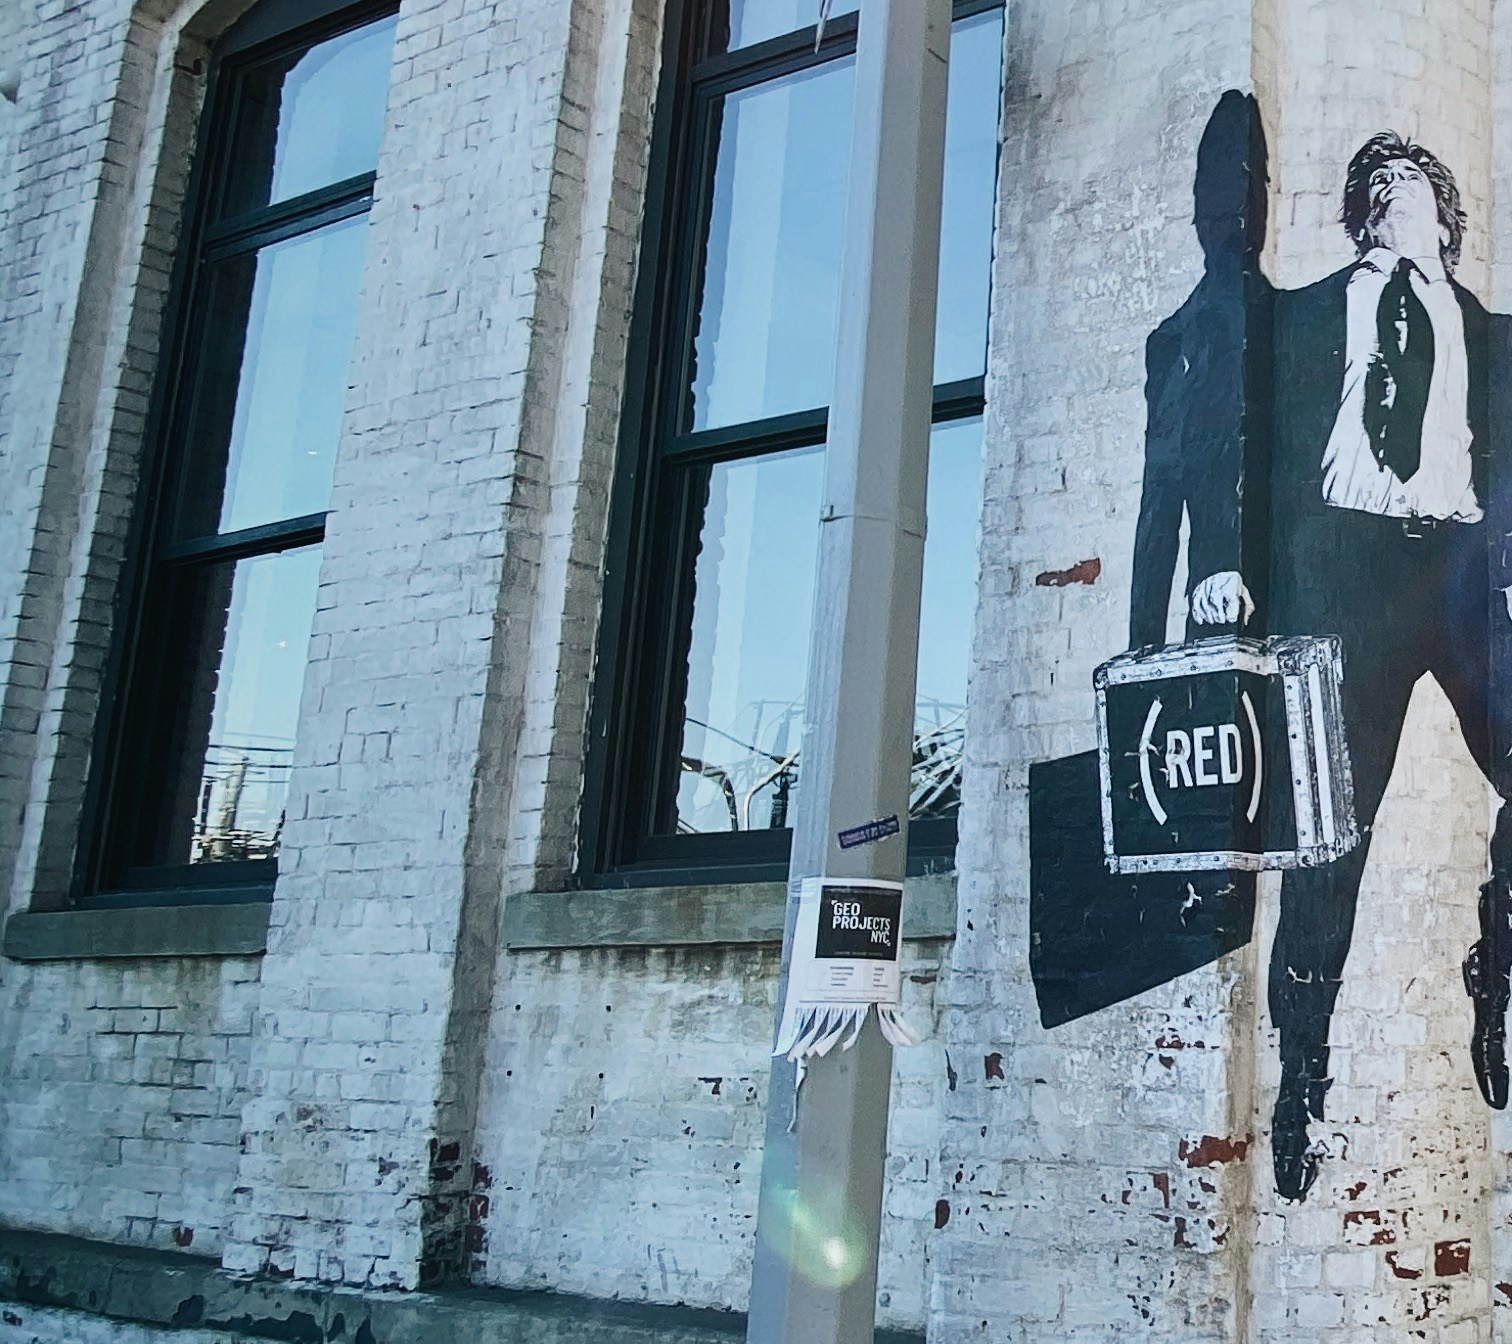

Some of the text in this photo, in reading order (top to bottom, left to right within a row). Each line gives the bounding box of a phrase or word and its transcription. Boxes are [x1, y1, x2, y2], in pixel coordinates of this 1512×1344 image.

[833, 902, 861, 916] GEO
[832, 915, 891, 931] PROJECTS
[870, 930, 890, 944] NYC
